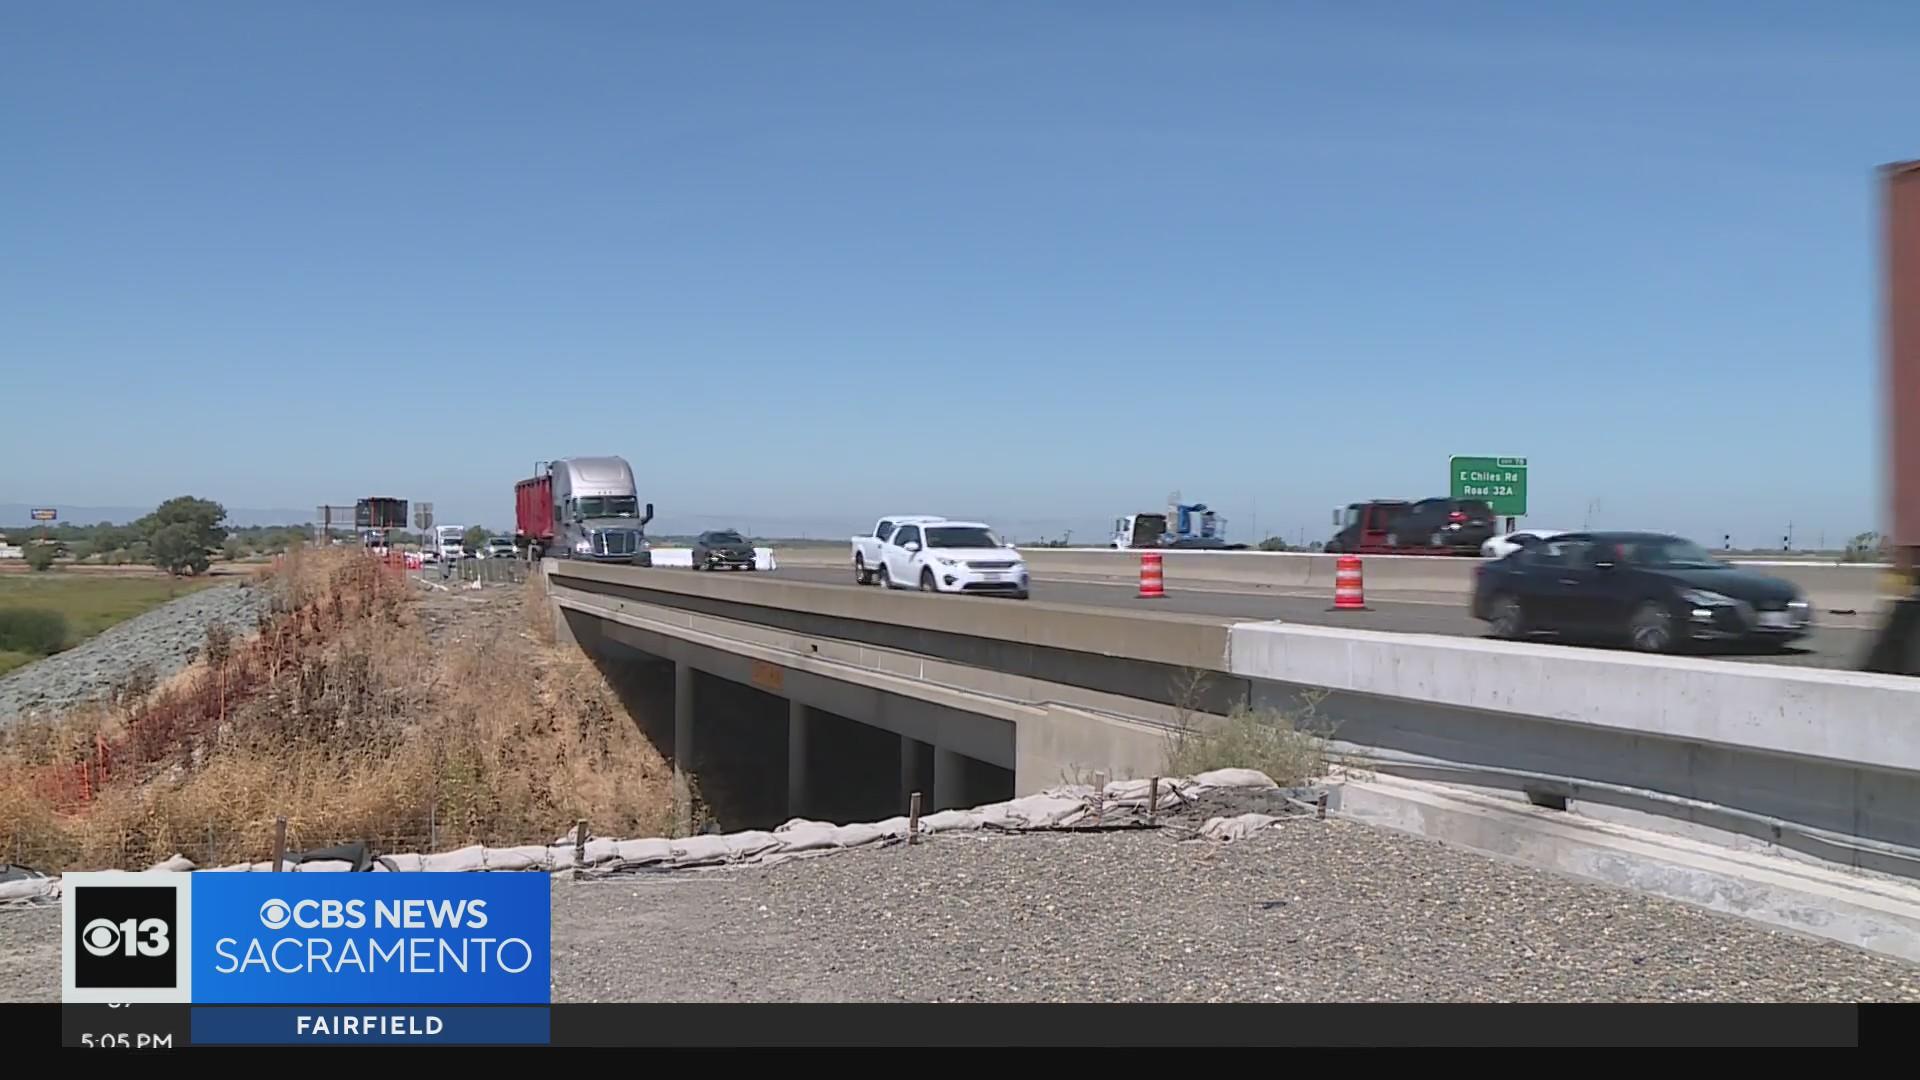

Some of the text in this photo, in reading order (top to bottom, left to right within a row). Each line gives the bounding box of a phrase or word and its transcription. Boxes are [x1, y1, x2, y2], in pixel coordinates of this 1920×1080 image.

[1460, 471, 1518, 482] E Chiles Rd
[1464, 486, 1513, 495] Road 32A
